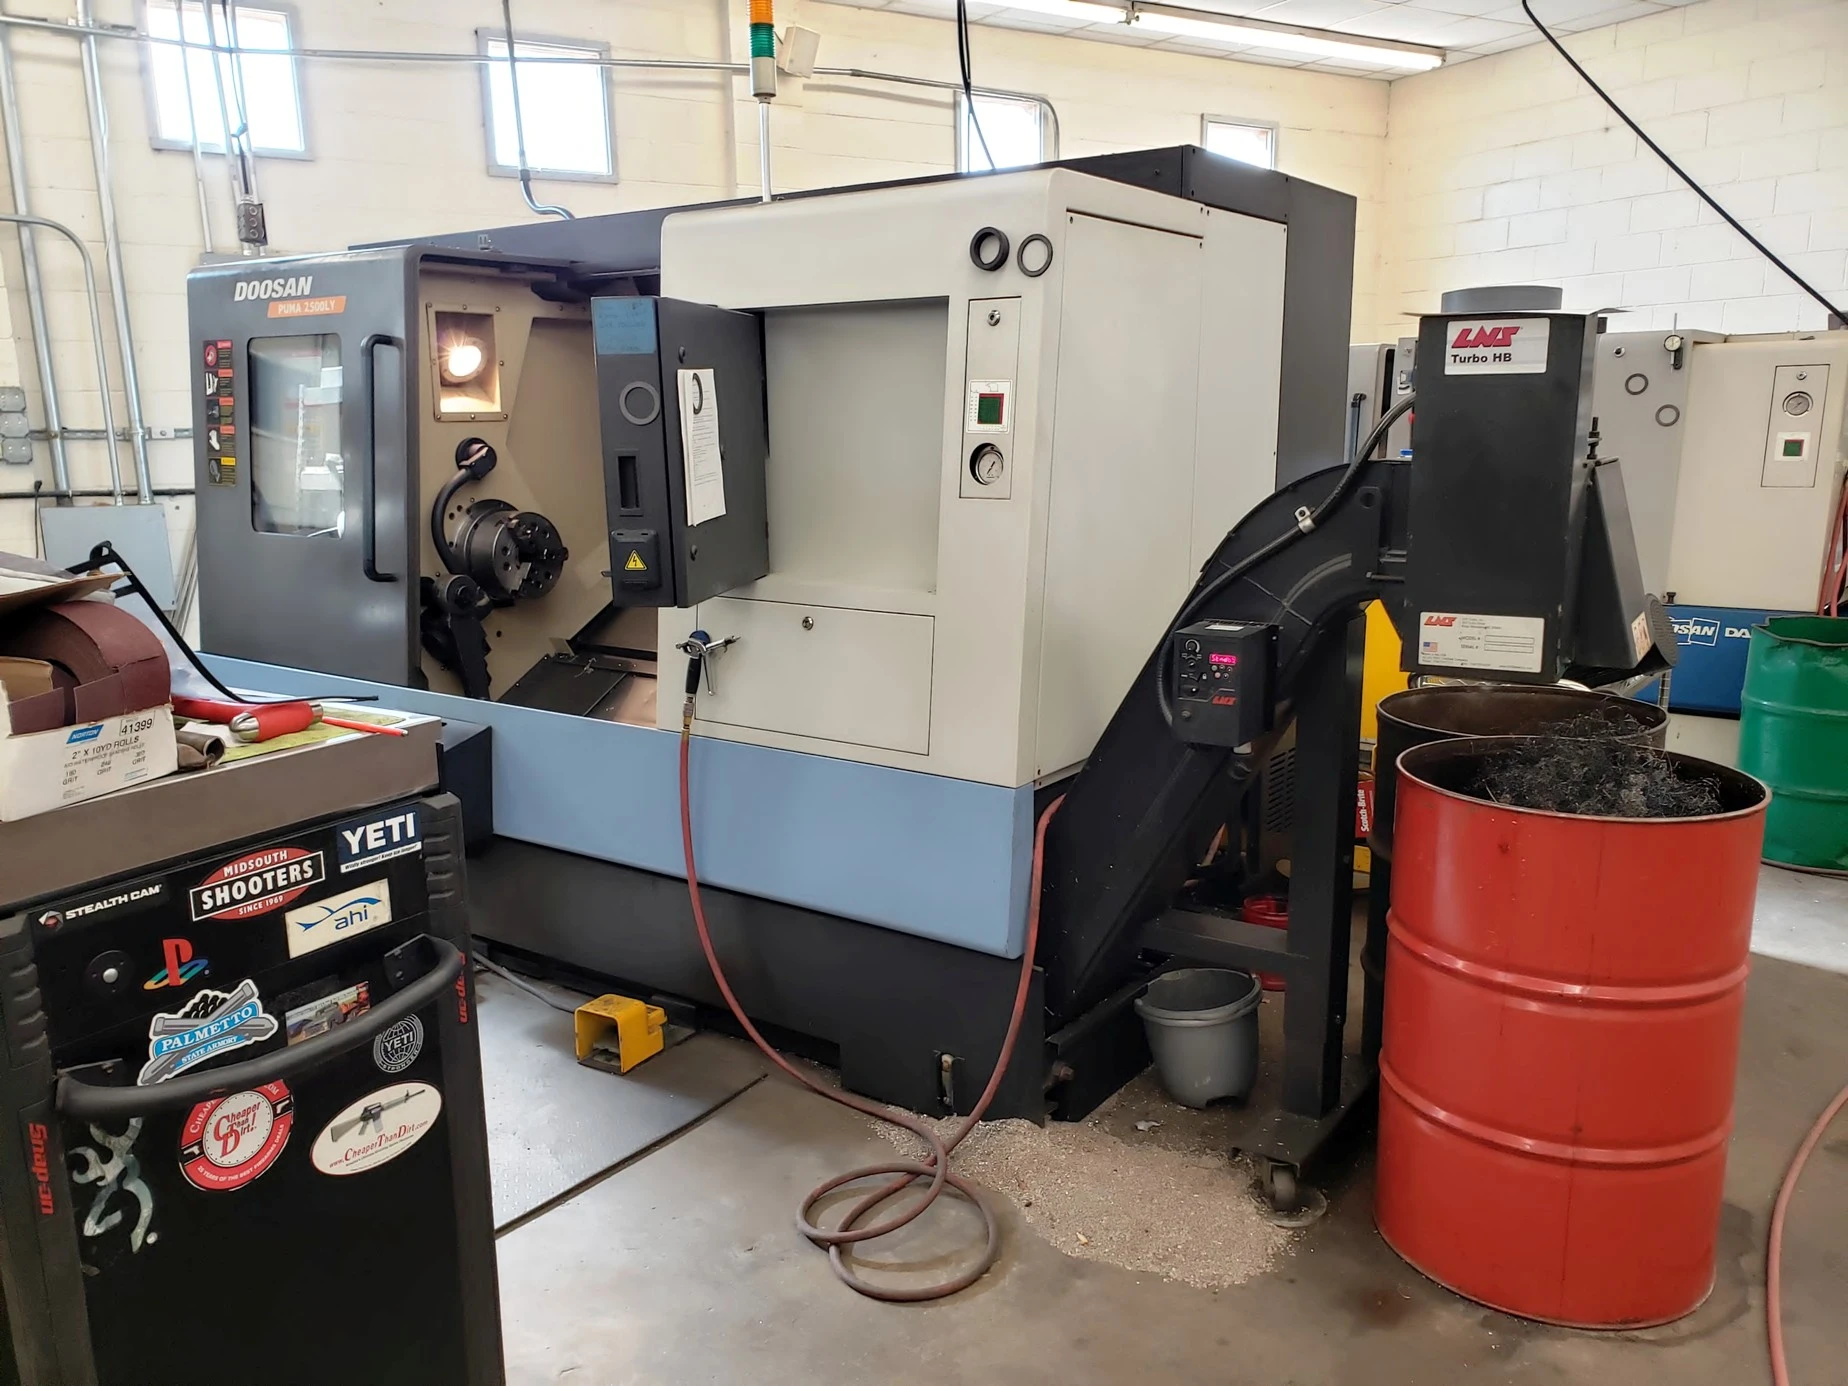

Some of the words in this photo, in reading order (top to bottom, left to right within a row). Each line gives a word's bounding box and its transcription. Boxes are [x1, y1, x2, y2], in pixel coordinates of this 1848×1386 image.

[234, 276, 313, 302] DOOSAN
[278, 301, 302, 314] PUMA
[304, 299, 336, 313] 2500LY
[1451, 325, 1521, 348] LNS
[1451, 354, 1488, 364] Turbo
[1493, 353, 1512, 363] HB
[121, 718, 153, 735] 41399
[72, 751, 81, 760] 2"
[83, 749, 90, 757] X
[92, 742, 113, 754] 10YD
[113, 736, 140, 748] ROLLS
[62, 776, 78, 786] GRIT
[341, 813, 416, 855] YETI
[223, 850, 288, 877] MIDSOUTH
[201, 860, 313, 910] SHOOTERS
[65, 894, 129, 920] STEALTH
[130, 885, 161, 901] CAM
[239, 902, 263, 915] SINCE
[265, 895, 284, 907] 1969
[334, 904, 368, 930] ahi
[160, 1006, 253, 1052] PALMETTO
[384, 1031, 413, 1052] YETI
[181, 1049, 205, 1064] STATE
[206, 1036, 239, 1051] ARMORY
[214, 1101, 261, 1141] Cheaper
[203, 1170, 219, 1182] YEARS
[239, 1167, 255, 1178] BEST
[254, 1143, 277, 1169] FIREARMS
[275, 1124, 285, 1144] DEALS
[329, 1120, 429, 1168] www.CheaperThanDirt.com
